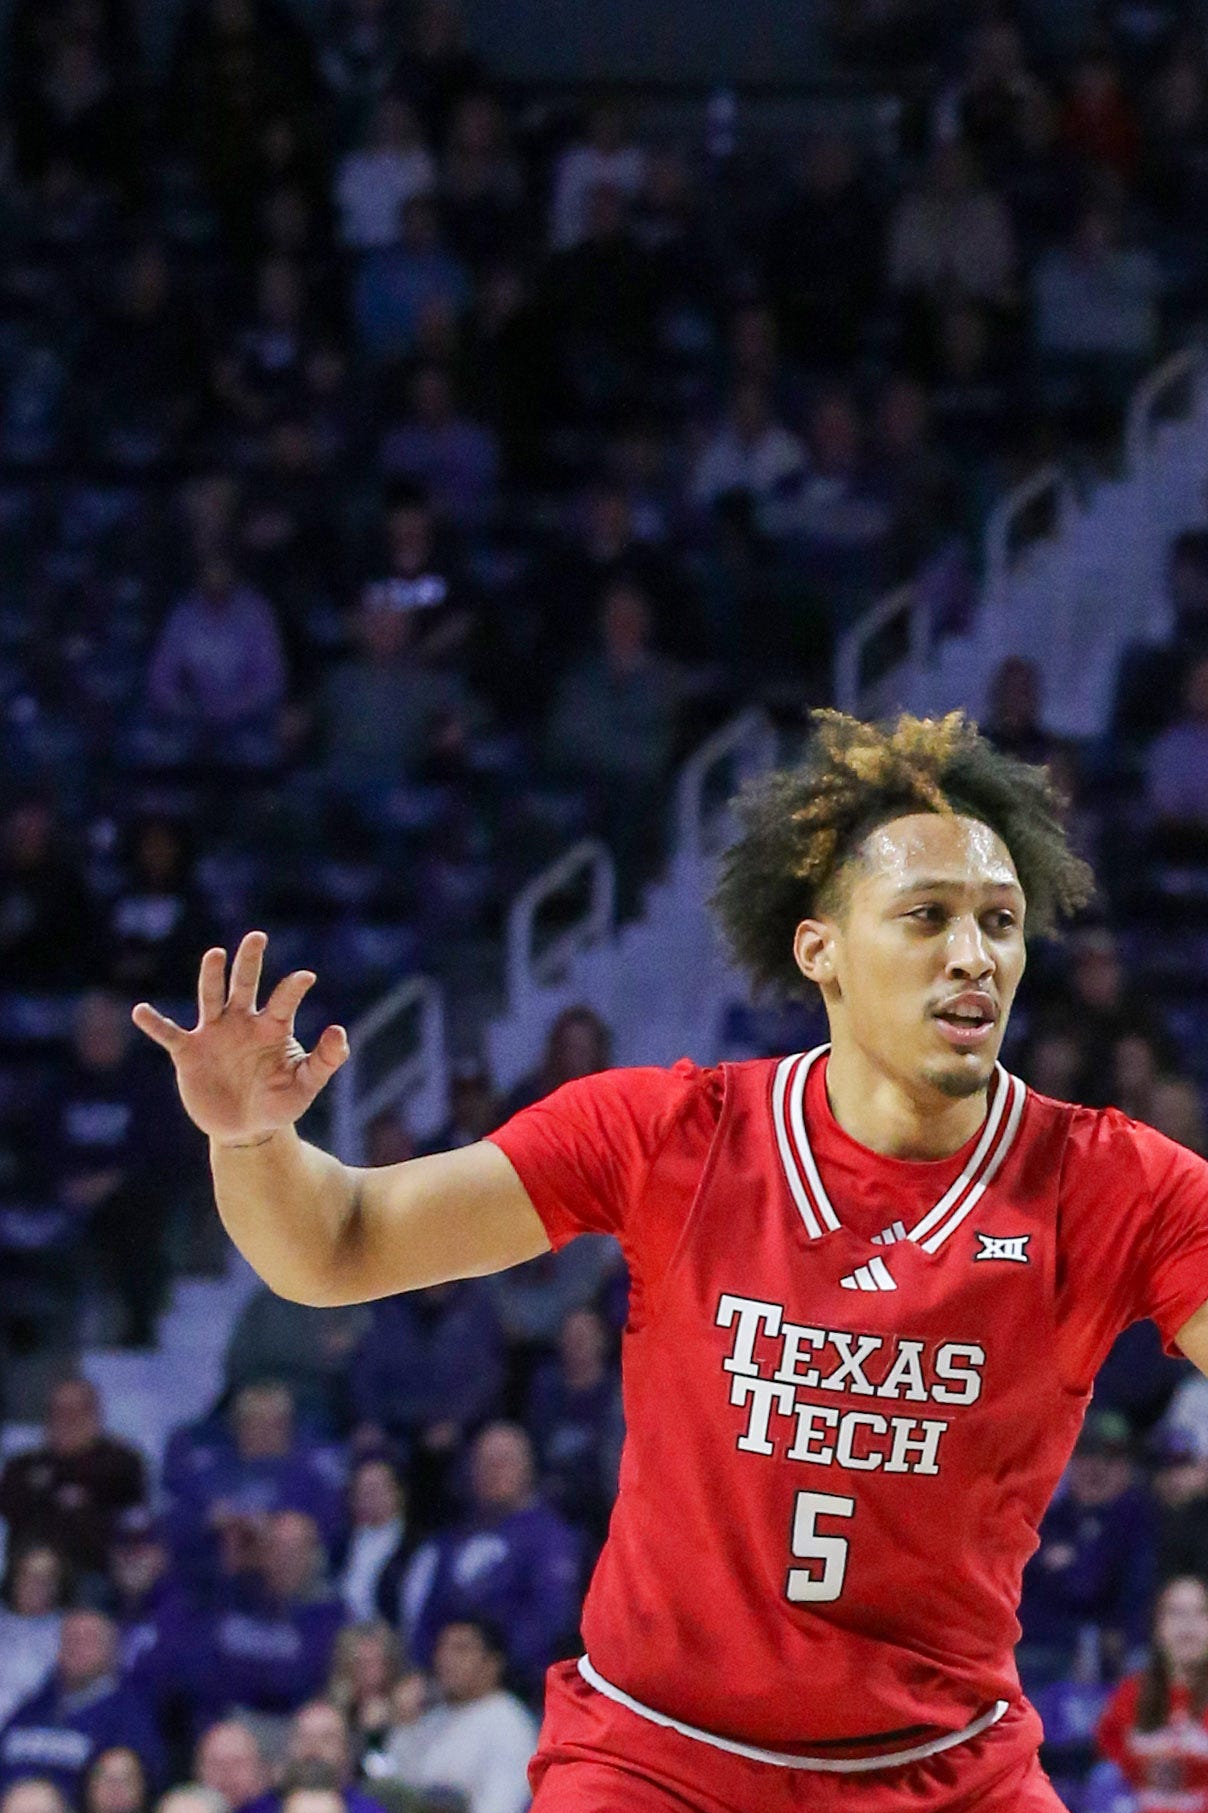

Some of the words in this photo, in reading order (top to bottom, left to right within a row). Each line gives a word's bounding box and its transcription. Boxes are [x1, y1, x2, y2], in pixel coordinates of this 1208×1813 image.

[974, 1231, 1031, 1264] XII
[715, 1292, 987, 1408] TEXAS
[728, 1373, 949, 1475] TECH
[785, 1490, 855, 1603] 5
